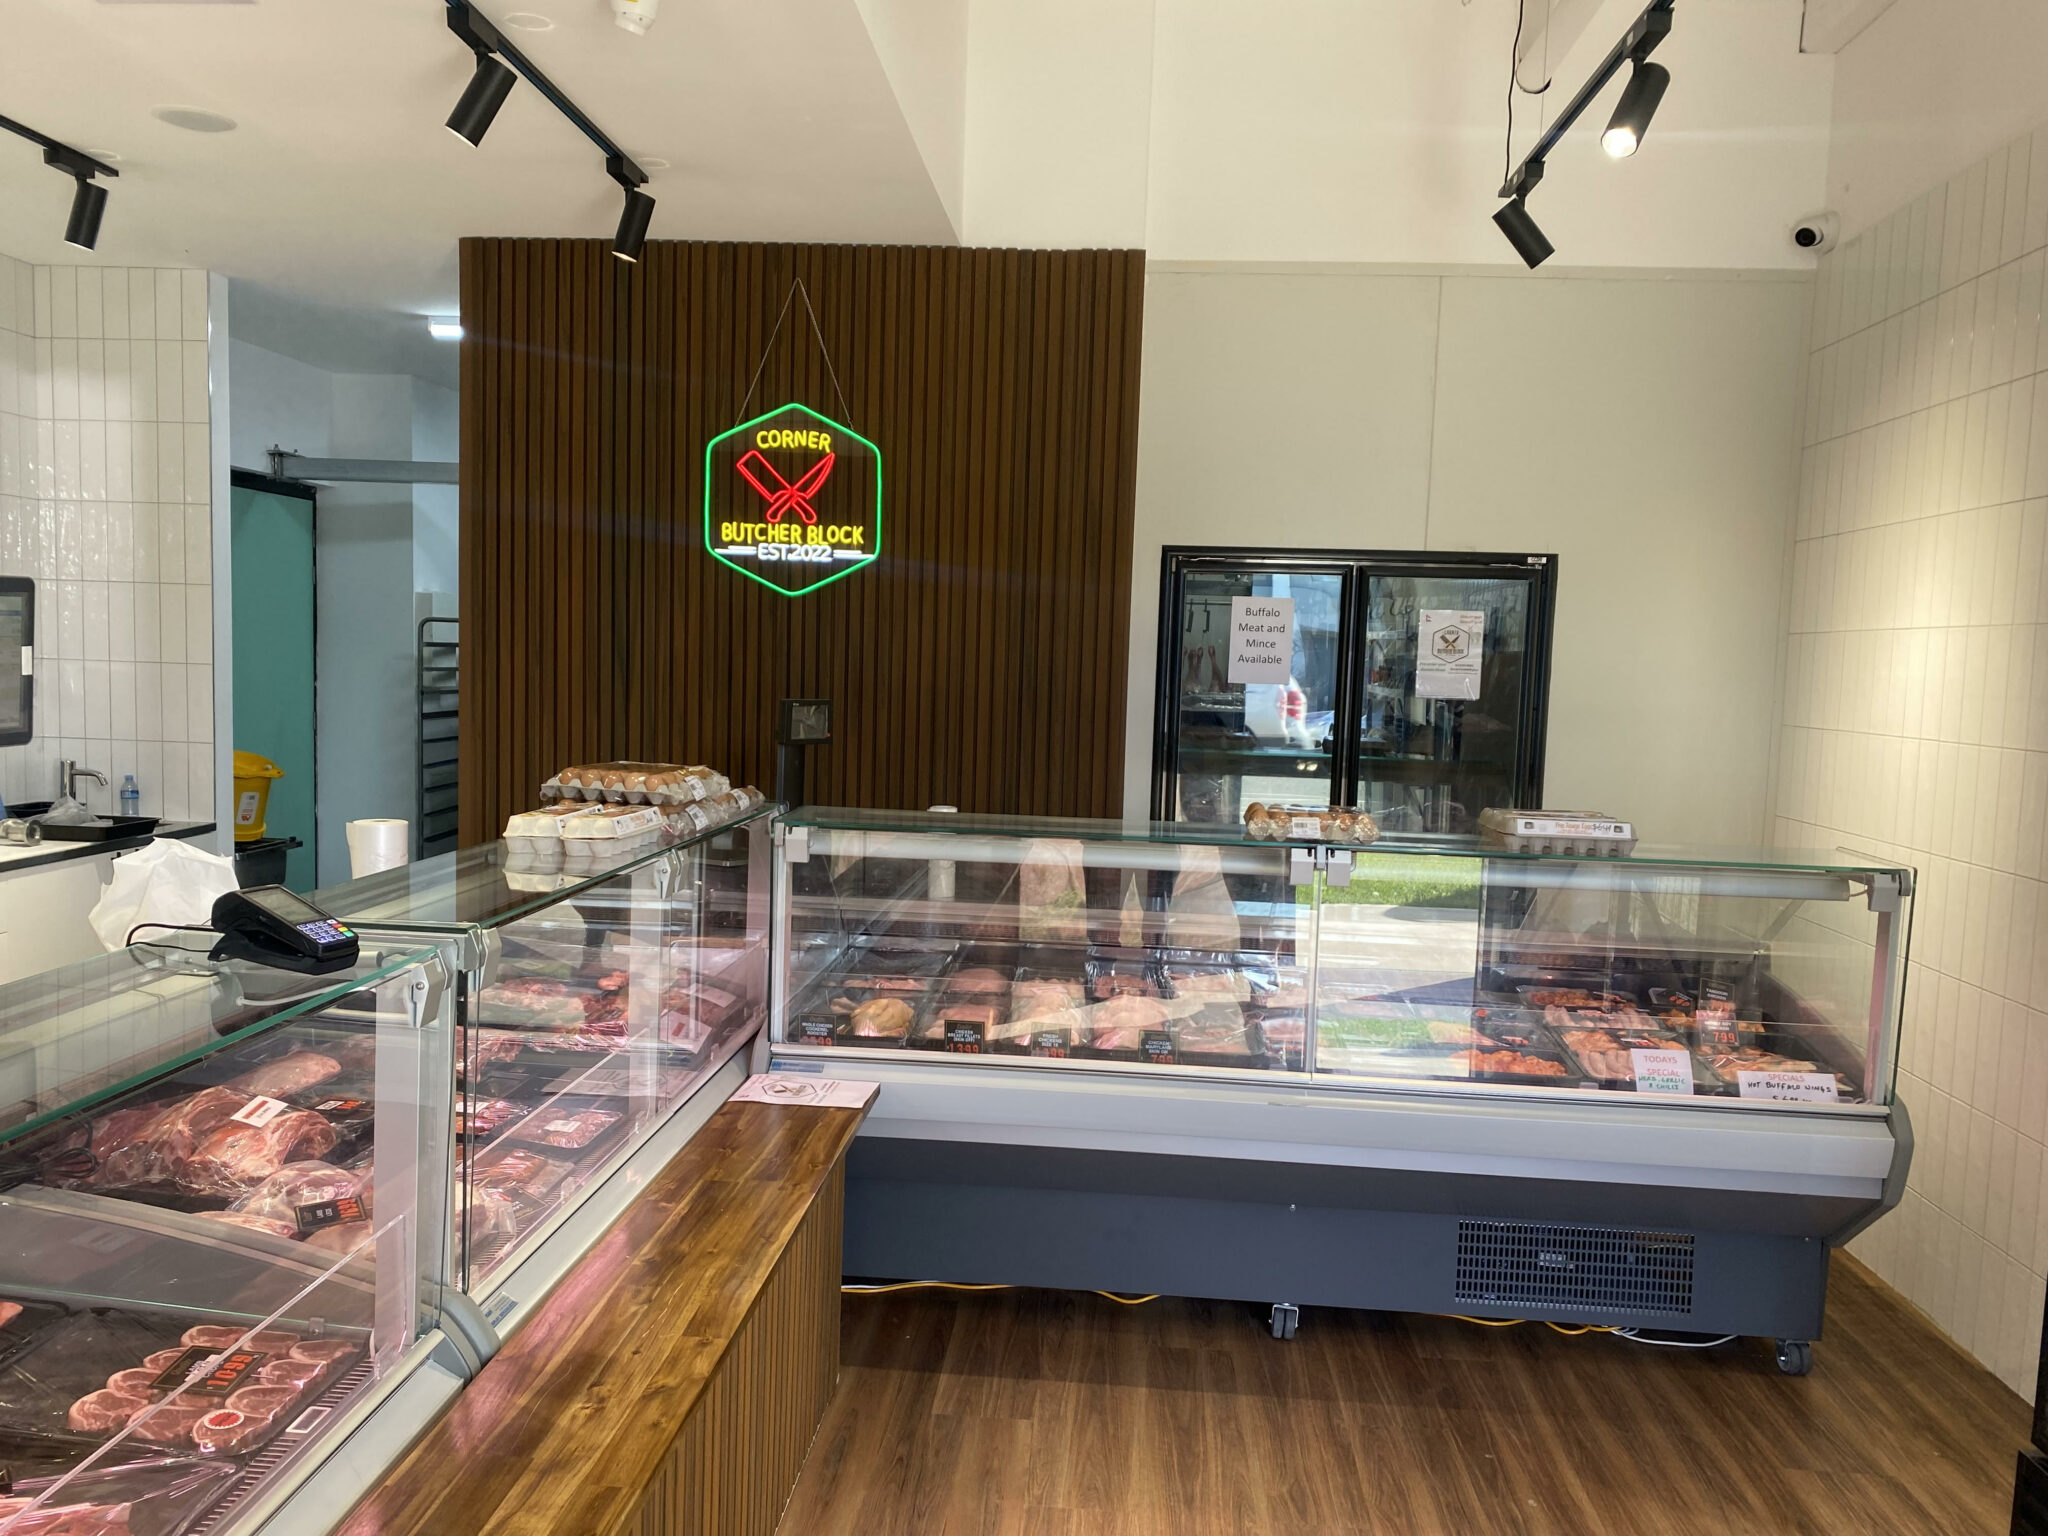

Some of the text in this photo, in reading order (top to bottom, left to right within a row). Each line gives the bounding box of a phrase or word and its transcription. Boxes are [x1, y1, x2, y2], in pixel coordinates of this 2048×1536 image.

[756, 429, 832, 453] CORNER
[721, 521, 865, 546] BUTCHER BLOCK
[1245, 607, 1281, 617] Buffalo
[1238, 623, 1286, 633] Meat and
[1245, 639, 1277, 649] Mince
[1237, 654, 1283, 664] Available
[1643, 1055, 1678, 1064] TODAYS
[1647, 1068, 1681, 1077] SPECIAL
[1768, 1073, 1805, 1082] SPECIALS
[1765, 1081, 1801, 1091] BUFFALO
[1804, 1085, 1832, 1093] WINGS
